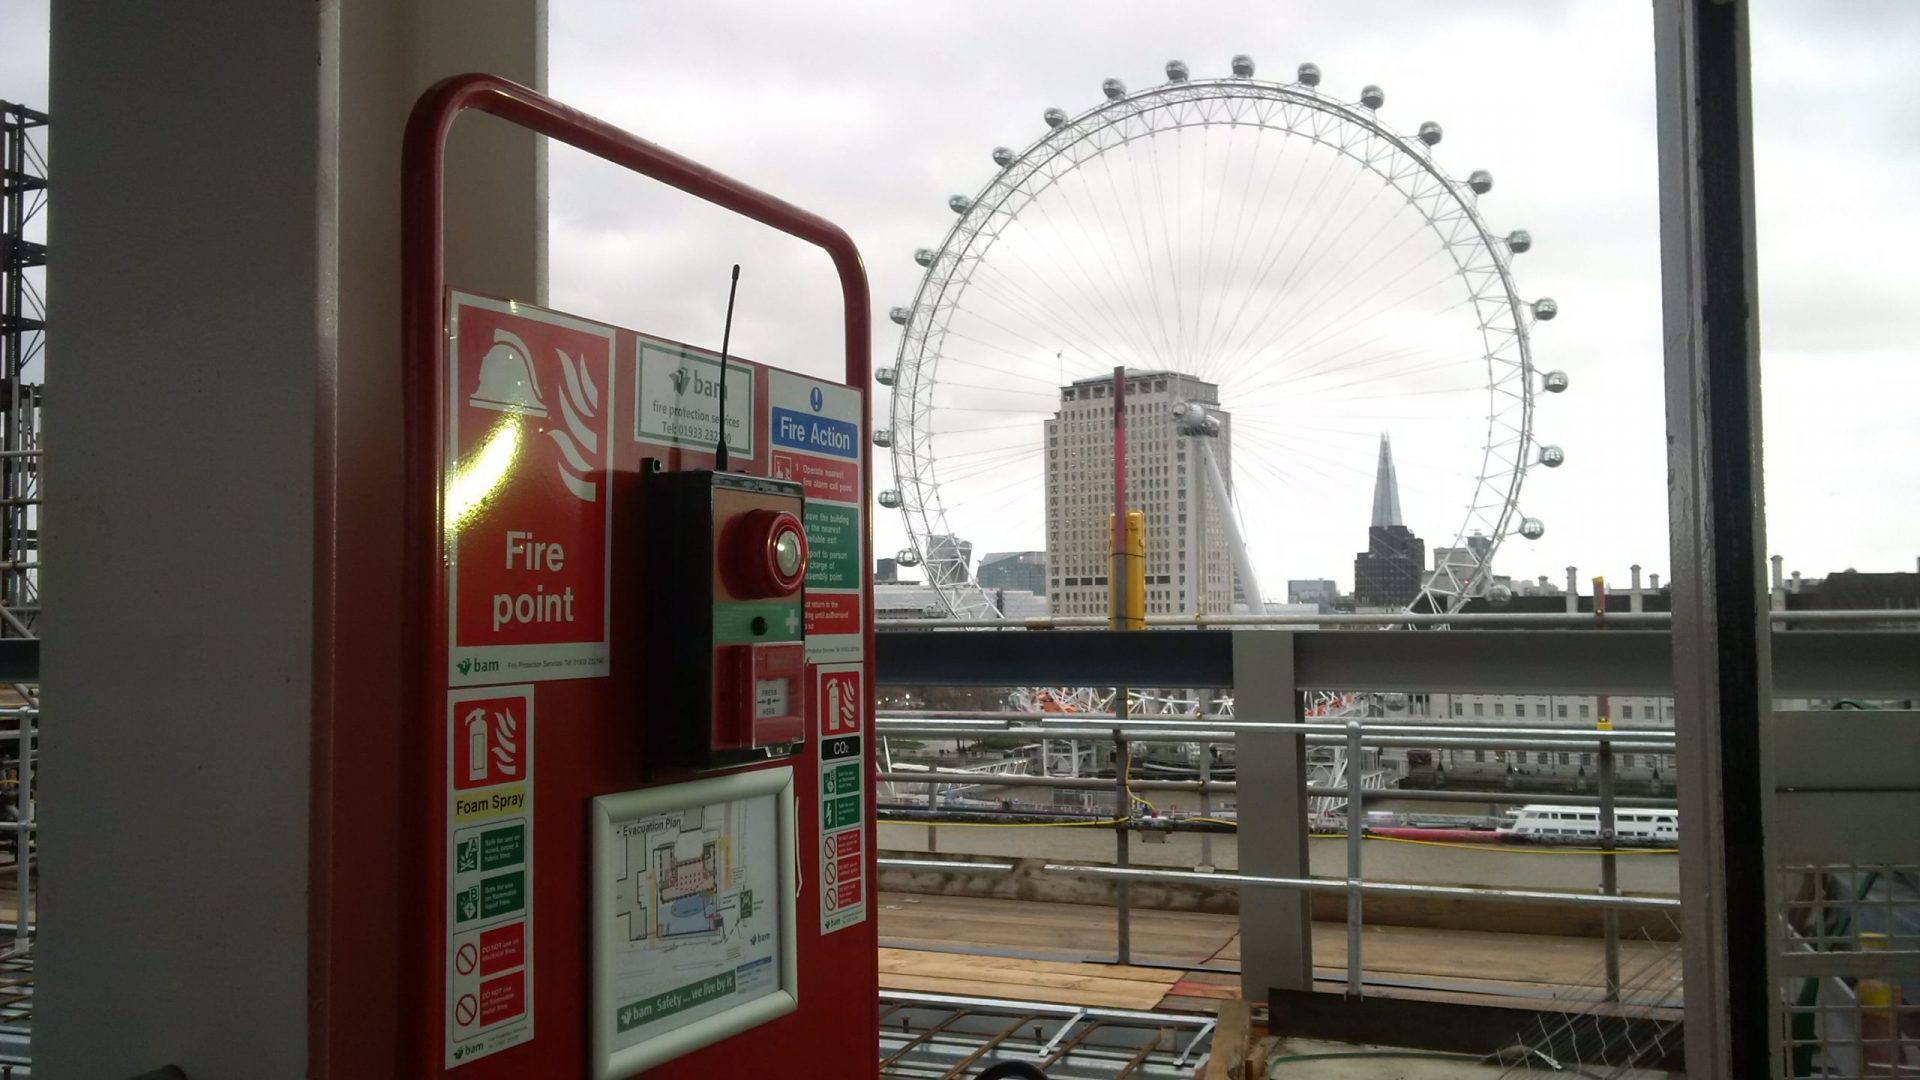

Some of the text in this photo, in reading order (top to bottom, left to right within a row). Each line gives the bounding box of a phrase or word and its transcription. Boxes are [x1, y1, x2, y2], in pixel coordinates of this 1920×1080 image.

[653, 400, 740, 428] fire protection seices
[679, 425, 702, 439] 01933
[780, 416, 850, 450] Fire Action
[803, 465, 824, 476] Operate
[825, 469, 844, 479] nearest
[814, 480, 828, 488] alarm
[830, 482, 838, 490] call
[840, 484, 852, 493] point
[806, 513, 849, 526] eave the building
[811, 524, 820, 532] the
[821, 526, 840, 534] nearest
[506, 531, 564, 572] Fire
[822, 550, 828, 558] to
[829, 552, 847, 560] person
[809, 562, 828, 570] charge
[493, 585, 574, 632] point
[474, 658, 499, 672] bam
[457, 793, 524, 815] Foam Spray
[623, 818, 681, 836] Evacuation Plan
[471, 840, 476, 850] A
[471, 889, 477, 899] B
[758, 933, 770, 943] bam
[482, 945, 490, 954] DO
[491, 942, 502, 950] NOT
[482, 992, 490, 1000] DO
[633, 1005, 652, 1020] bam
[657, 994, 682, 1012] Safety
[691, 988, 702, 999] we
[704, 983, 716, 996] live
[716, 977, 726, 992] by
[726, 976, 732, 987] it
[465, 1042, 483, 1055] bam
